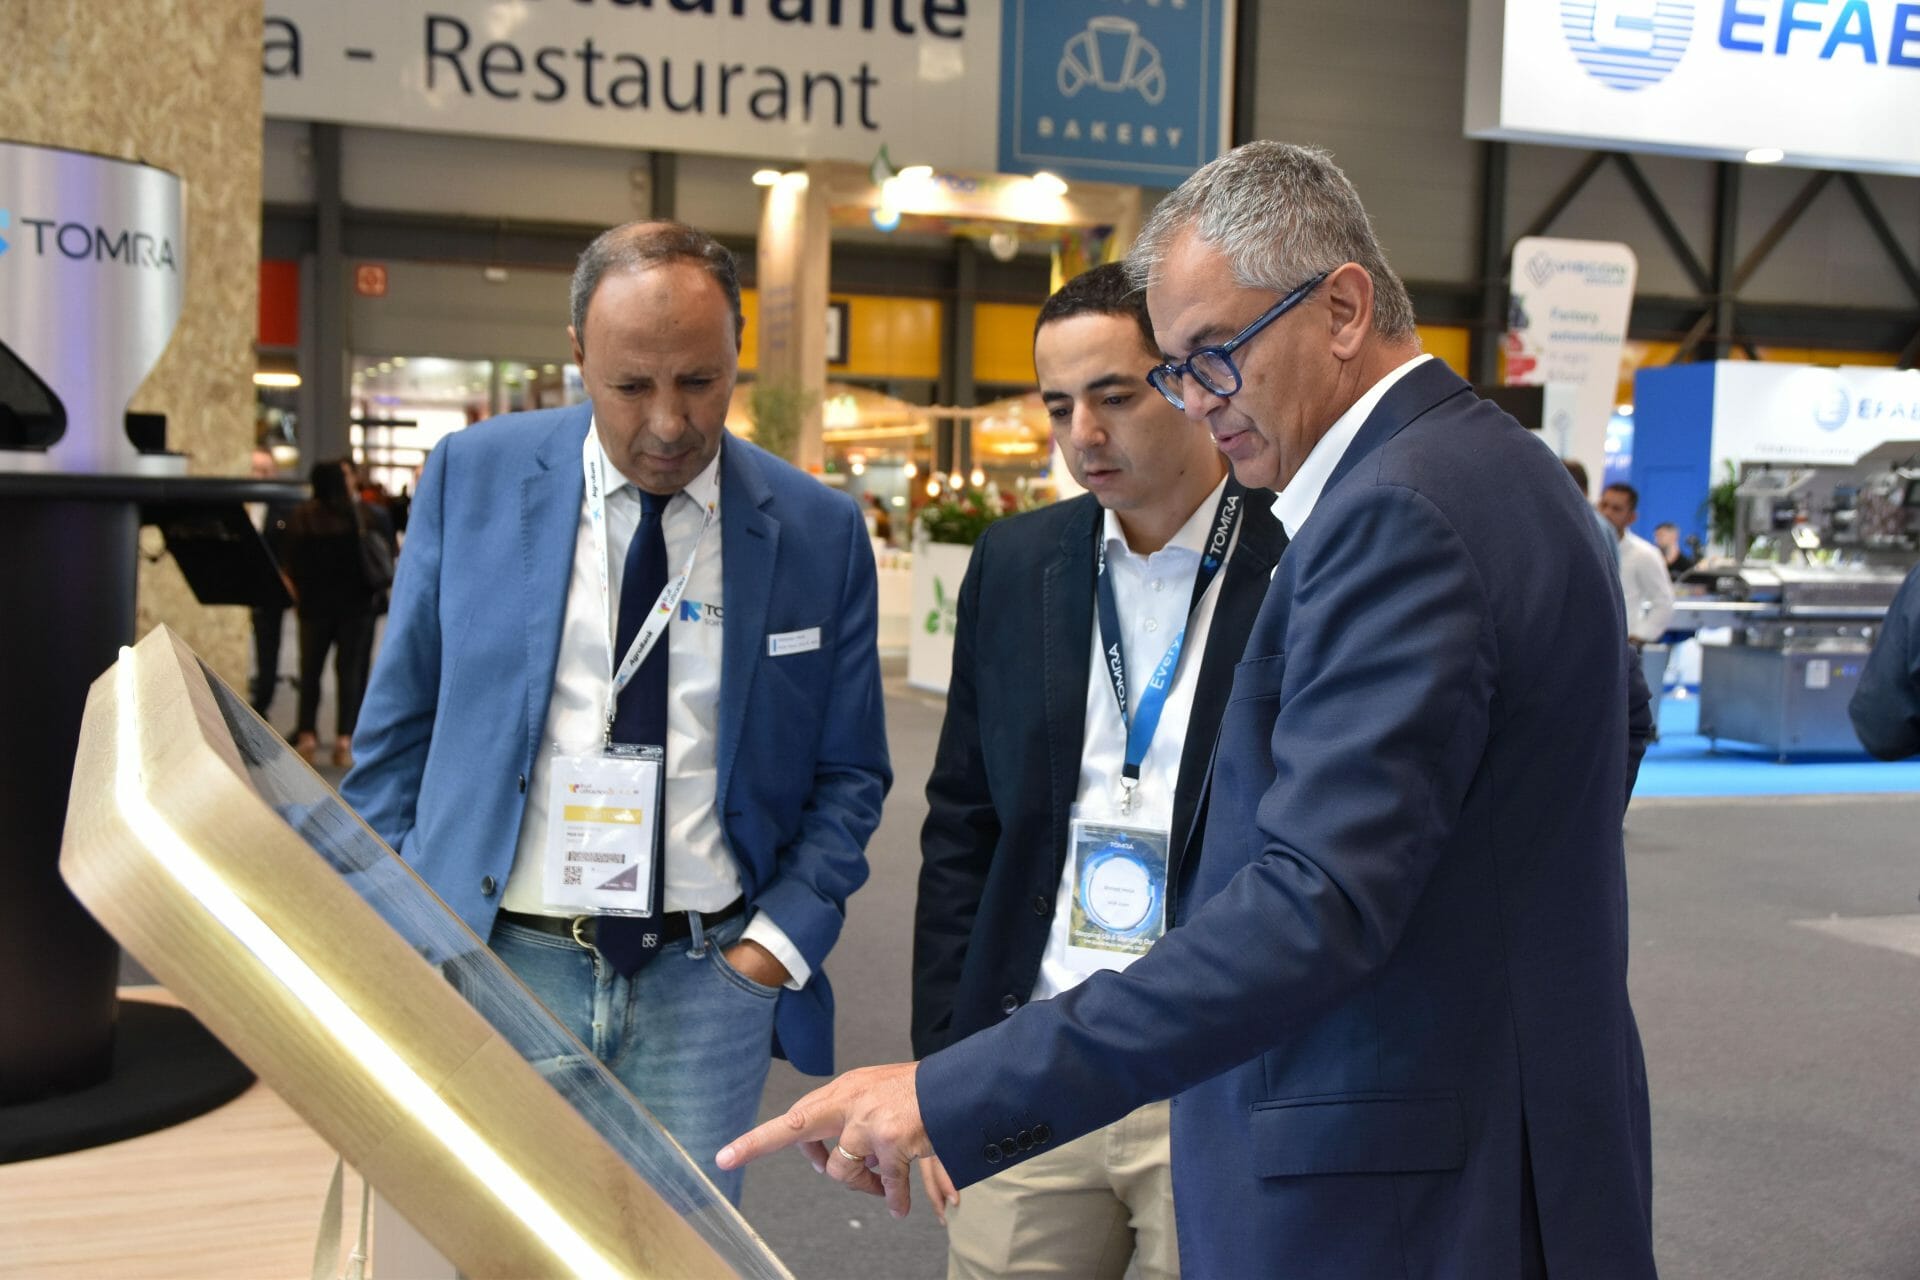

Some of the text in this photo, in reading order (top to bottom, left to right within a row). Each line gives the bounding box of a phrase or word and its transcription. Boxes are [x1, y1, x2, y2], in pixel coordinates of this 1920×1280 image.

[425, 14, 880, 131] Restaurant
[1037, 115, 1183, 148] BAKERY
[20, 217, 177, 272] TOMRA
[1210, 495, 1240, 554] TOMRA
[629, 630, 653, 667] AgroBank
[1108, 642, 1125, 710] TOMRA
[1149, 639, 1180, 690] Every
